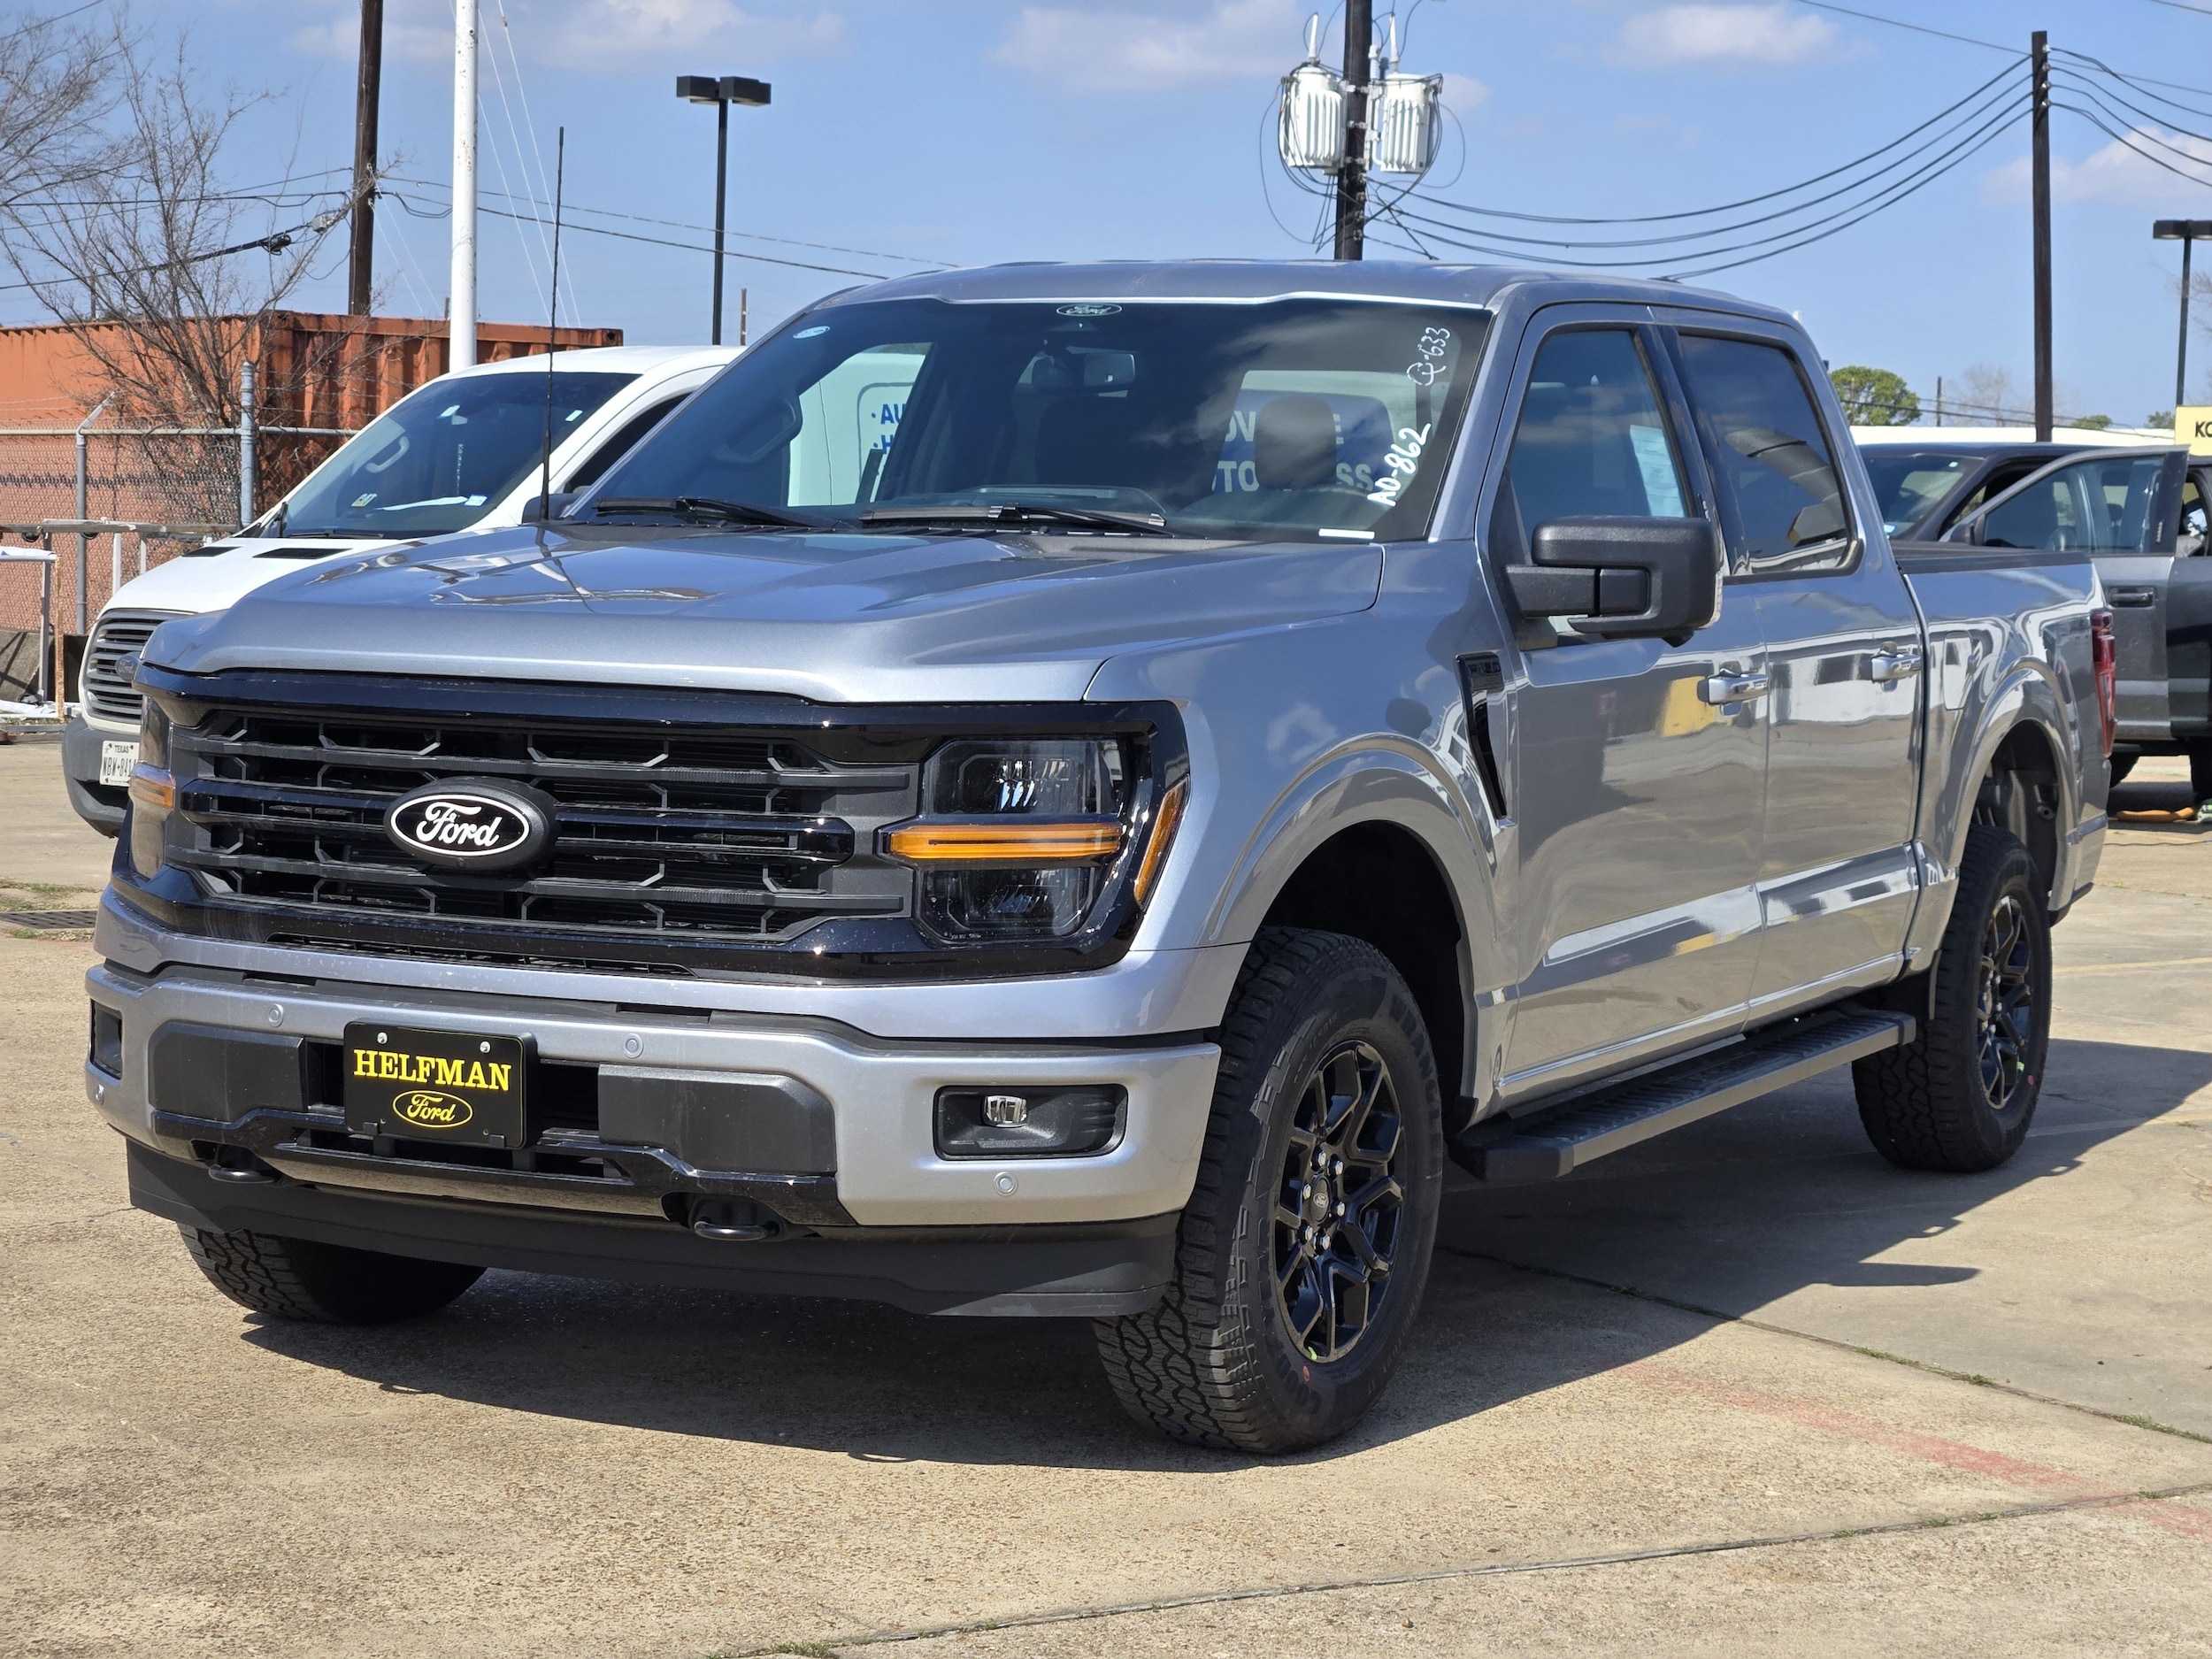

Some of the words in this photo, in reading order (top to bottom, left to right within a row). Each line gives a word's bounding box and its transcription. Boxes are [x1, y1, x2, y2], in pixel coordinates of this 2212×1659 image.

[114, 745, 129, 754] TEXAS
[416, 802, 503, 847] Ford
[353, 1049, 511, 1091] HELFMAN
[407, 1094, 457, 1122] Ford
